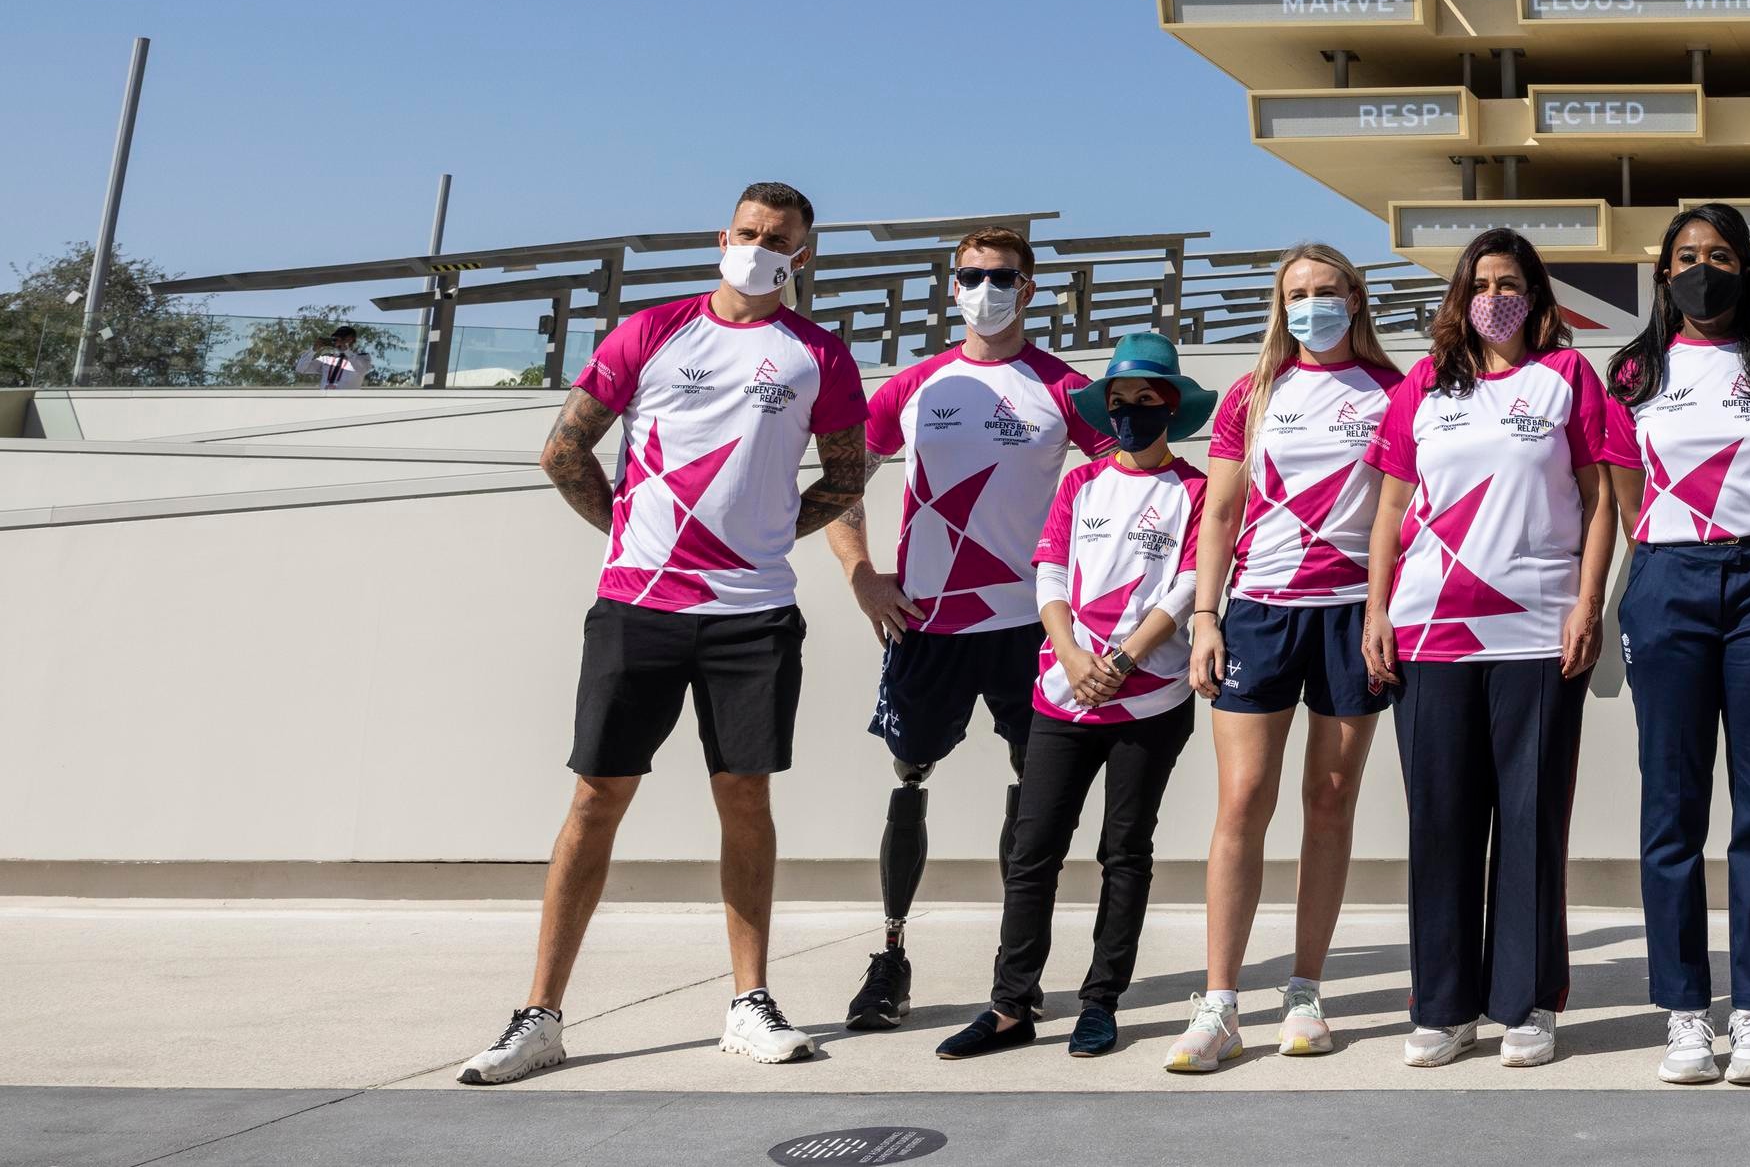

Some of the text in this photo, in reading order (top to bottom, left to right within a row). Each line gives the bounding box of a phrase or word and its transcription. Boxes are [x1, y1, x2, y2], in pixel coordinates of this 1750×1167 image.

[1360, 104, 1453, 128] RESP-
[1545, 102, 1644, 125] ECTED
[744, 385, 798, 401] QUEEN'S BATON
[760, 394, 783, 405] RELAY
[984, 420, 1040, 433] QUEEN'S BATON
[1500, 418, 1555, 429] QUEEN'S BATON
[1517, 425, 1540, 433] RELAY
[1000, 429, 1024, 438] RELAY
